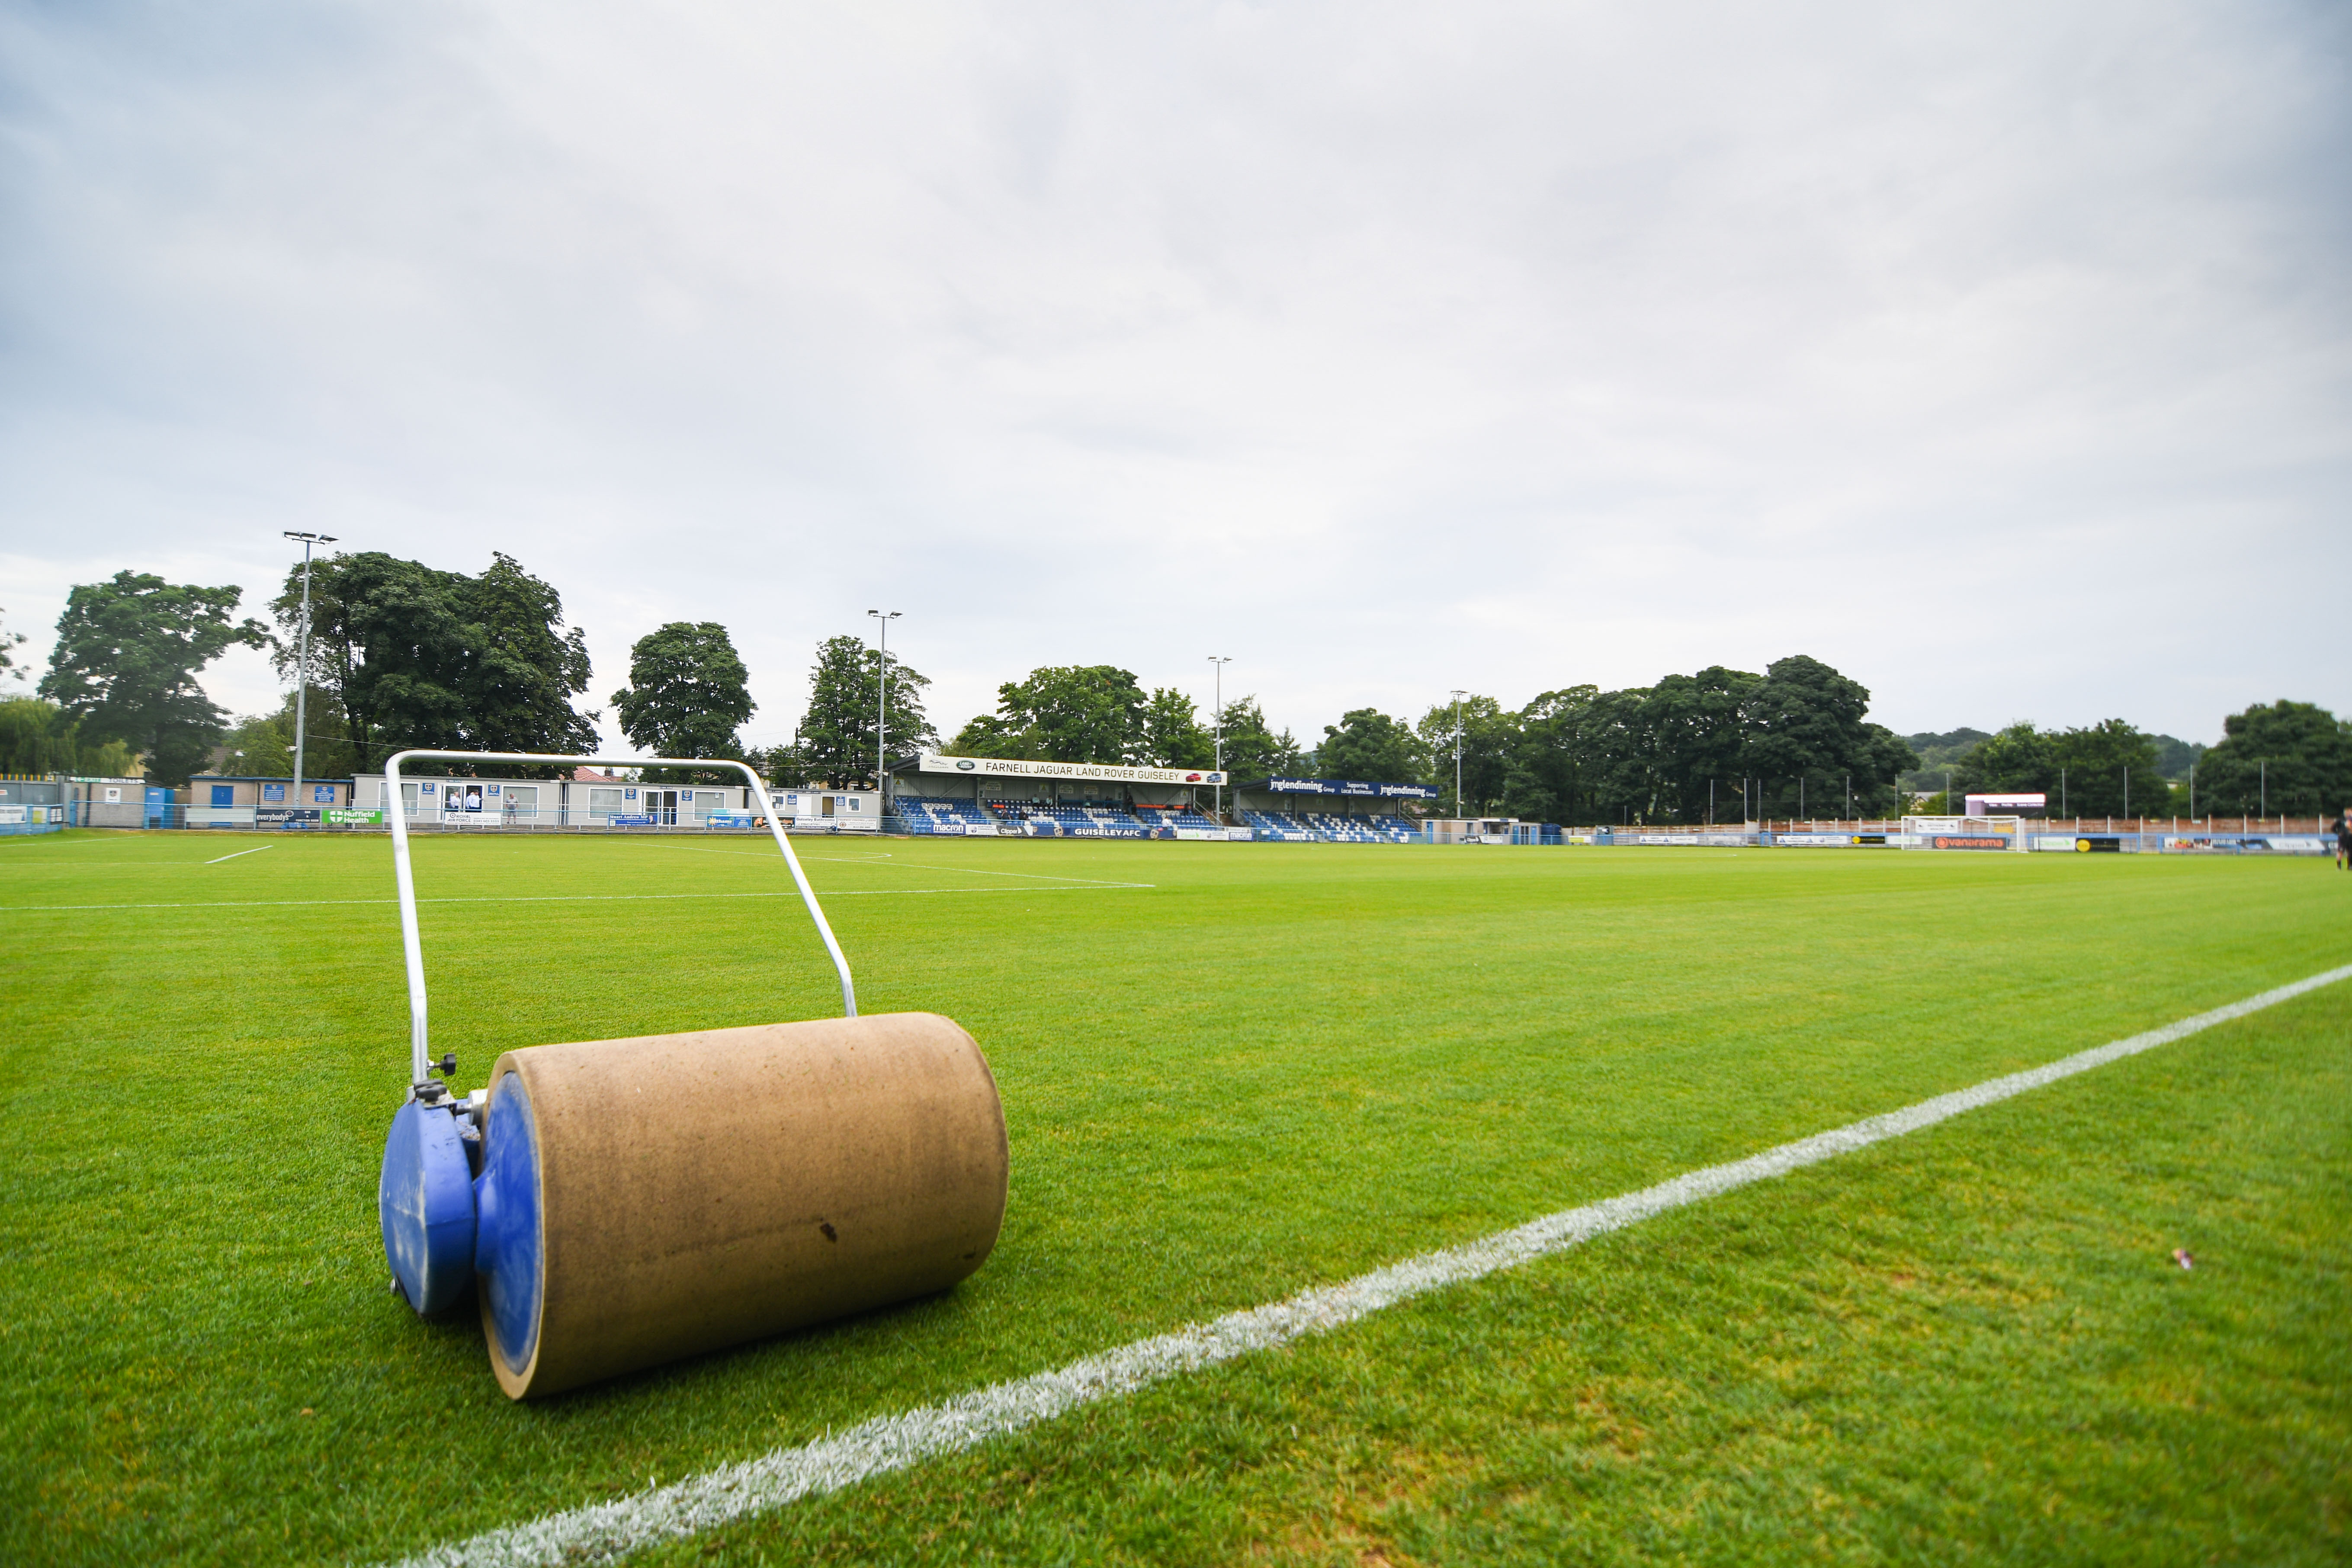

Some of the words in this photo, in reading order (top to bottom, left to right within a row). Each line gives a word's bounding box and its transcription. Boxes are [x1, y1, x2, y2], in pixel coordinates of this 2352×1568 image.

[986, 762, 1031, 773] FARNELL
[1034, 765, 1072, 776] JAGUAR
[1076, 767, 1101, 776] LAND
[1104, 769, 1134, 778] ROVER
[1138, 771, 1179, 781] GUISELEY
[1346, 782, 1369, 790] Supporting
[257, 813, 289, 822] everybodys
[1948, 838, 2004, 847] vanarama
